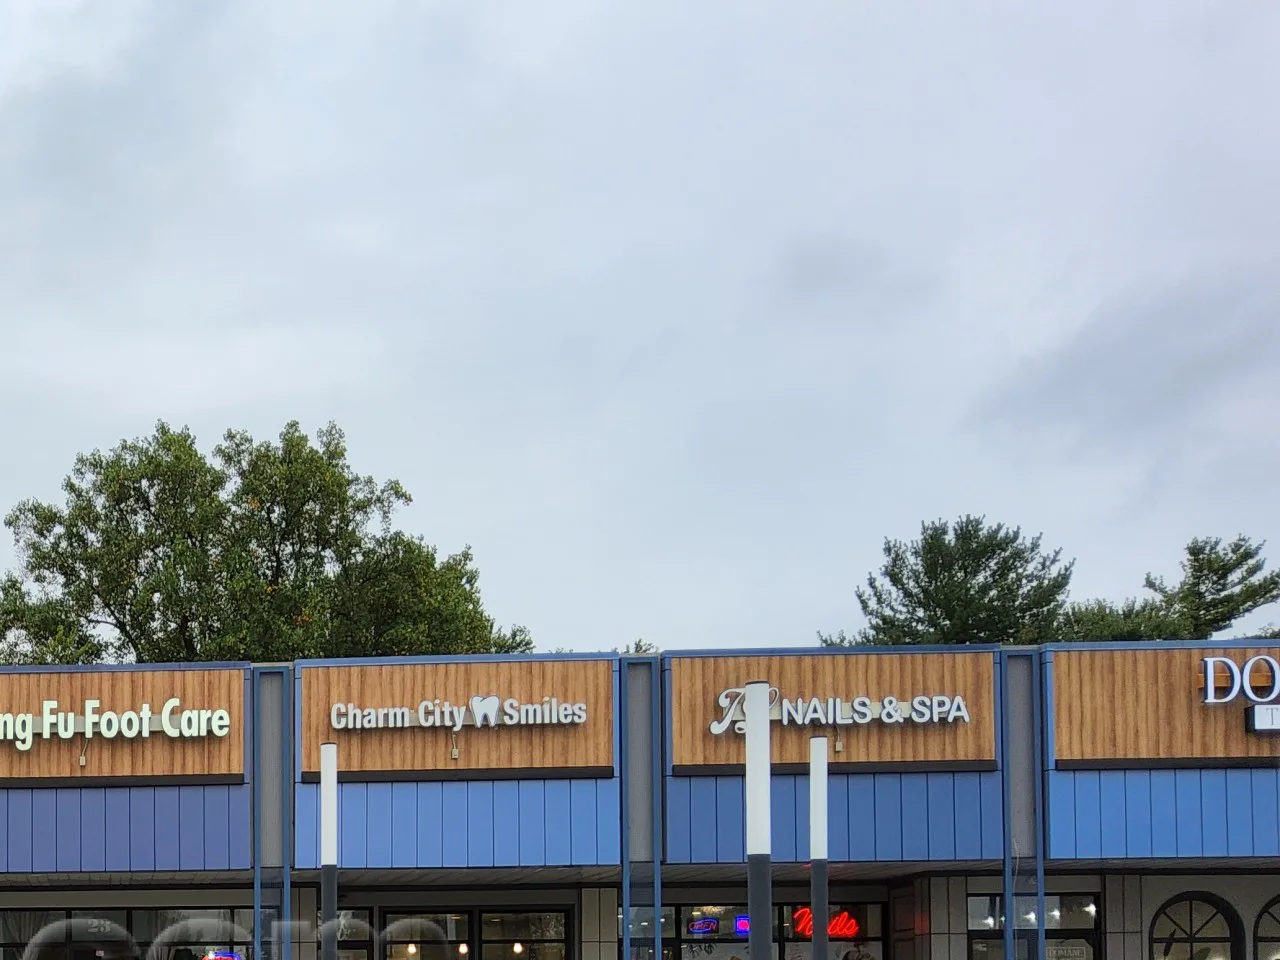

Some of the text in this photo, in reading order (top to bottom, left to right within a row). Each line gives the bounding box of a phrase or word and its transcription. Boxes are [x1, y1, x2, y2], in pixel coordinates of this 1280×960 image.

[1202, 655, 1280, 703] DO
[42, 700, 75, 739] Fu
[85, 699, 152, 739] Foot
[161, 697, 231, 738] Care
[330, 696, 588, 731] Charm City Smiles
[782, 697, 872, 726] NAILS
[880, 696, 905, 723] &
[911, 695, 970, 723] SPA
[87, 919, 112, 933] 23
[793, 907, 860, 937] Nils
